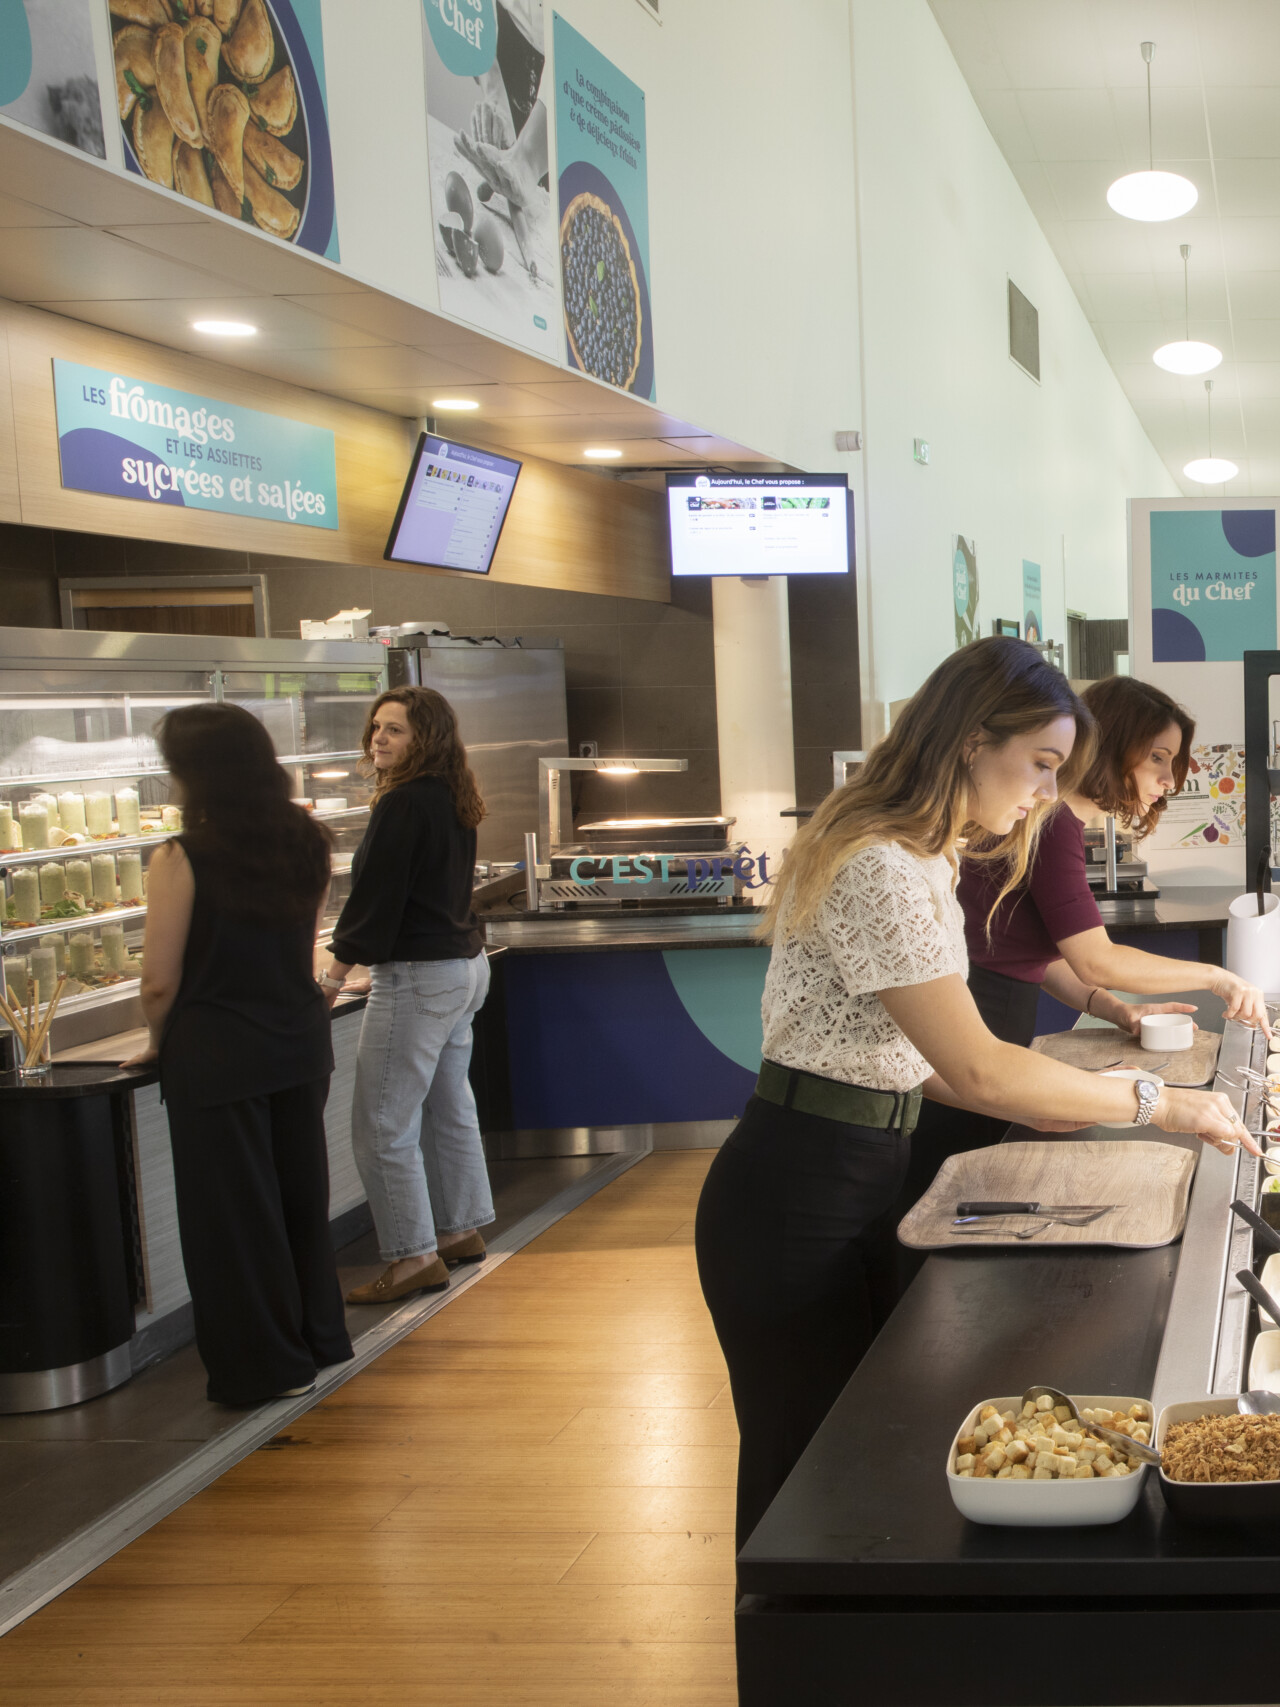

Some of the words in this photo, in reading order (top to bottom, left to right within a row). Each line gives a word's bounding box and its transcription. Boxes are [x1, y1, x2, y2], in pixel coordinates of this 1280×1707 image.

[440, 0, 484, 50] Chef
[563, 80, 585, 107] d'une
[585, 101, 609, 127] crème
[609, 119, 641, 153] pâtissière
[576, 68, 585, 87] La
[585, 79, 630, 124] combinaison
[576, 113, 586, 132] de
[586, 120, 619, 158] délicieux
[82, 385, 106, 406] LES
[108, 376, 236, 445] fromages
[166, 438, 180, 455] ET
[183, 441, 203, 460] LES
[206, 447, 263, 472] ASSIETTES
[121, 457, 224, 500] sucrées
[229, 475, 254, 504] et
[257, 480, 326, 520] salées
[711, 478, 744, 486] Aujourd'hui,
[1169, 572, 1189, 581] LES
[1195, 571, 1258, 581] MARMITES
[1172, 583, 1200, 607] du
[1205, 580, 1256, 601] Chef
[569, 854, 675, 886] C'EST
[685, 846, 778, 890] prêt
